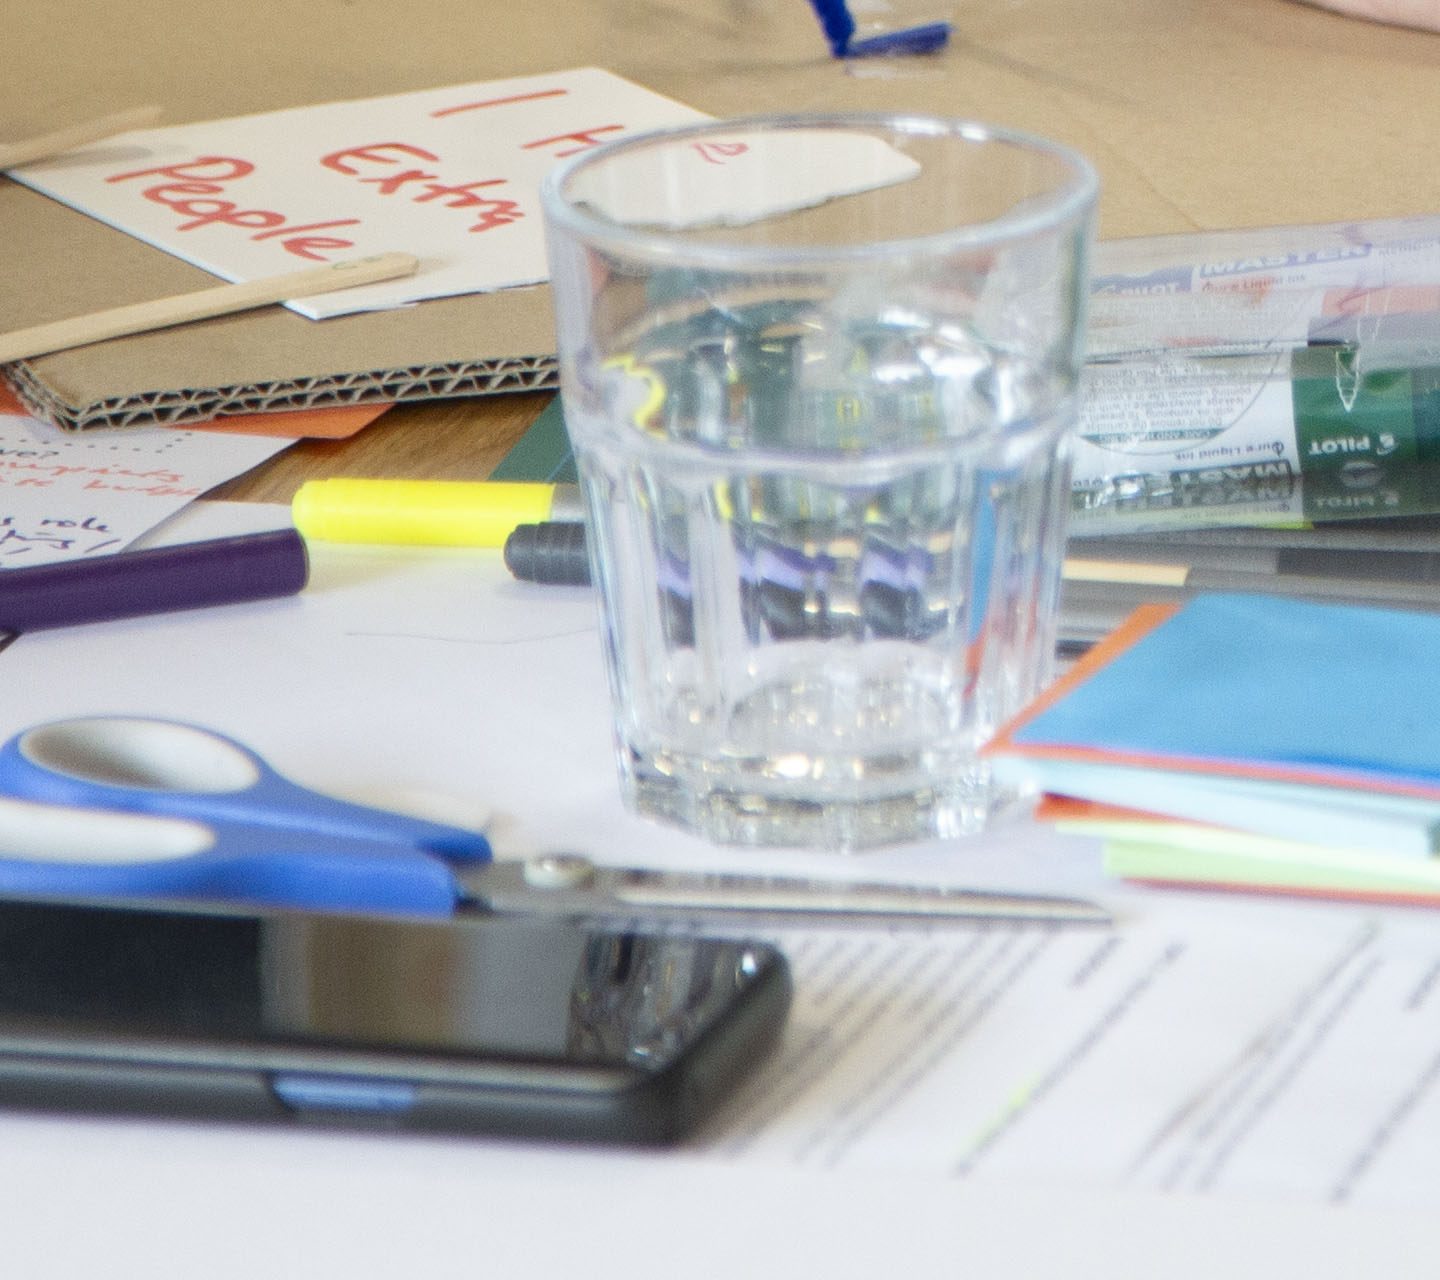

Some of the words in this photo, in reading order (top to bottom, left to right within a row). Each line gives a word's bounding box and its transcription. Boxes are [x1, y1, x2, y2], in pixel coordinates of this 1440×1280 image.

[106, 155, 361, 262] People
[319, 142, 528, 233] Extra
[1308, 435, 1371, 456] PILOT
